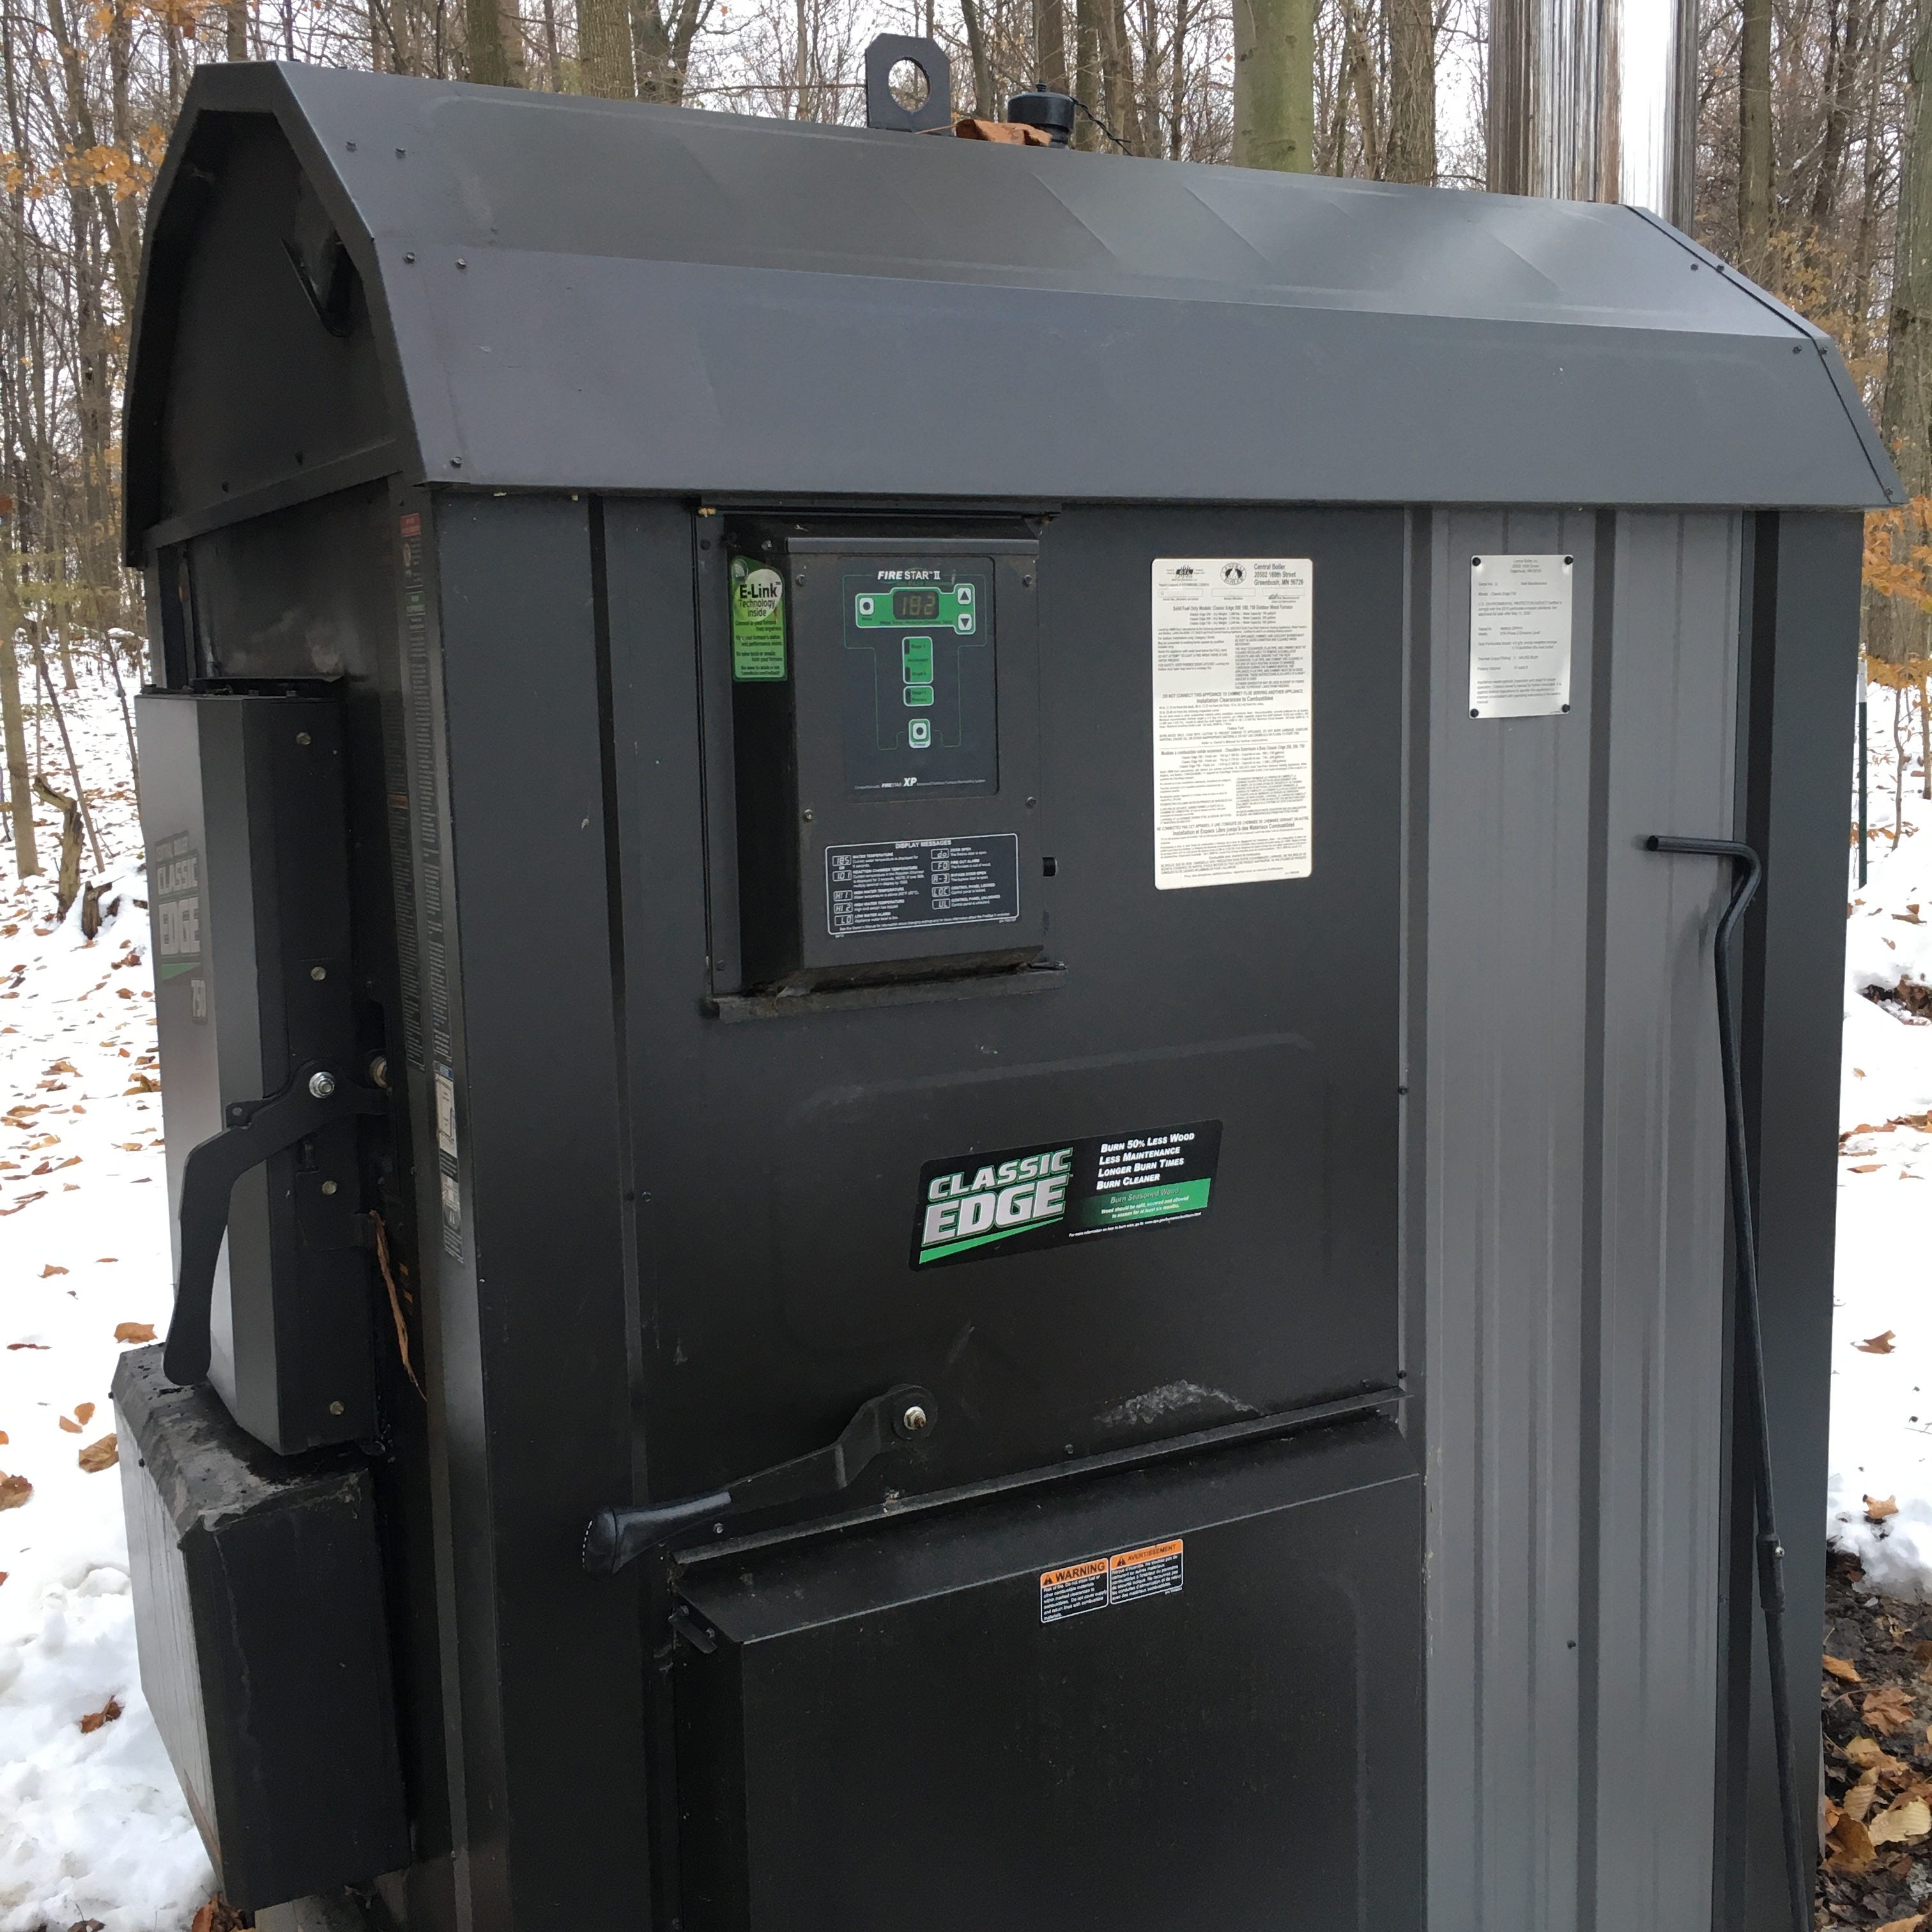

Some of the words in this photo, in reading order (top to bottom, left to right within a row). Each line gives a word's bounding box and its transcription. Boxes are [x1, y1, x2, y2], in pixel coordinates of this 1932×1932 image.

[739, 599, 776, 609] Technology
[747, 608, 767, 617] Inside
[902, 595, 936, 615] 182
[903, 777, 917, 787] XP
[157, 857, 198, 894] CLASSIC
[158, 896, 201, 955] EDGE
[1101, 1142, 1124, 1153] BURN
[1127, 1139, 1145, 1149] 50%
[1147, 1136, 1167, 1146] LESS
[1170, 1133, 1195, 1143] WOOD
[1099, 1155, 1120, 1165] LESS
[1123, 1146, 1181, 1162] MAINTENANCE
[928, 1148, 1072, 1201] CLASSIC
[1098, 1165, 1131, 1177] LONGER
[1134, 1162, 1156, 1172] BURN
[1160, 1158, 1184, 1168] TIMES
[1096, 1179, 1121, 1190] BURN
[1123, 1174, 1160, 1186] CLEANER
[1110, 1195, 1126, 1204] Burn
[1128, 1191, 1160, 1201] Seasoned
[1161, 1187, 1180, 1196] Wood
[923, 1174, 1069, 1246] EDGE
[1128, 1544, 1176, 1560] AVERTISSEMENT
[1055, 1562, 1105, 1581] WARNING
